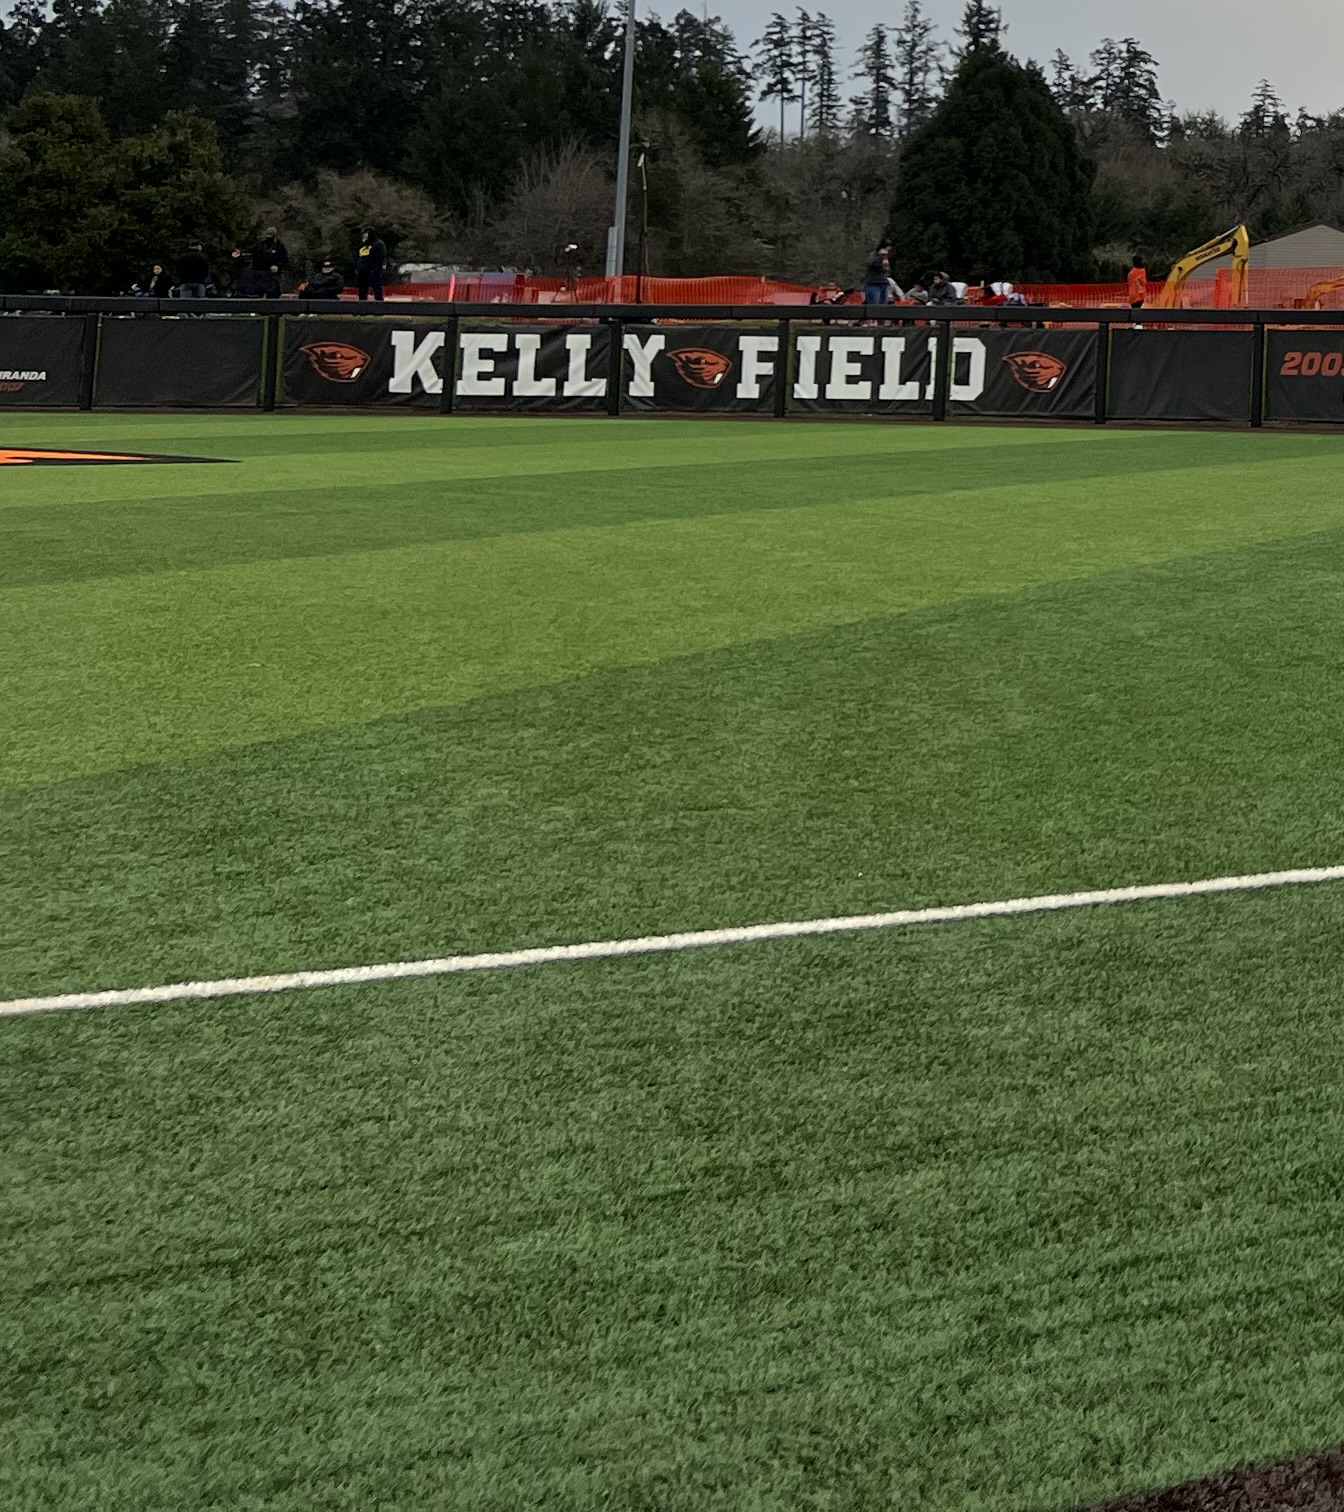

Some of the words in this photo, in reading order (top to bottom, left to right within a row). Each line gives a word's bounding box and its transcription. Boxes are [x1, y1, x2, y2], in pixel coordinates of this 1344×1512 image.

[0, 371, 46, 380] IRANDA
[389, 330, 665, 396] KELLY
[736, 336, 987, 401] FIELD
